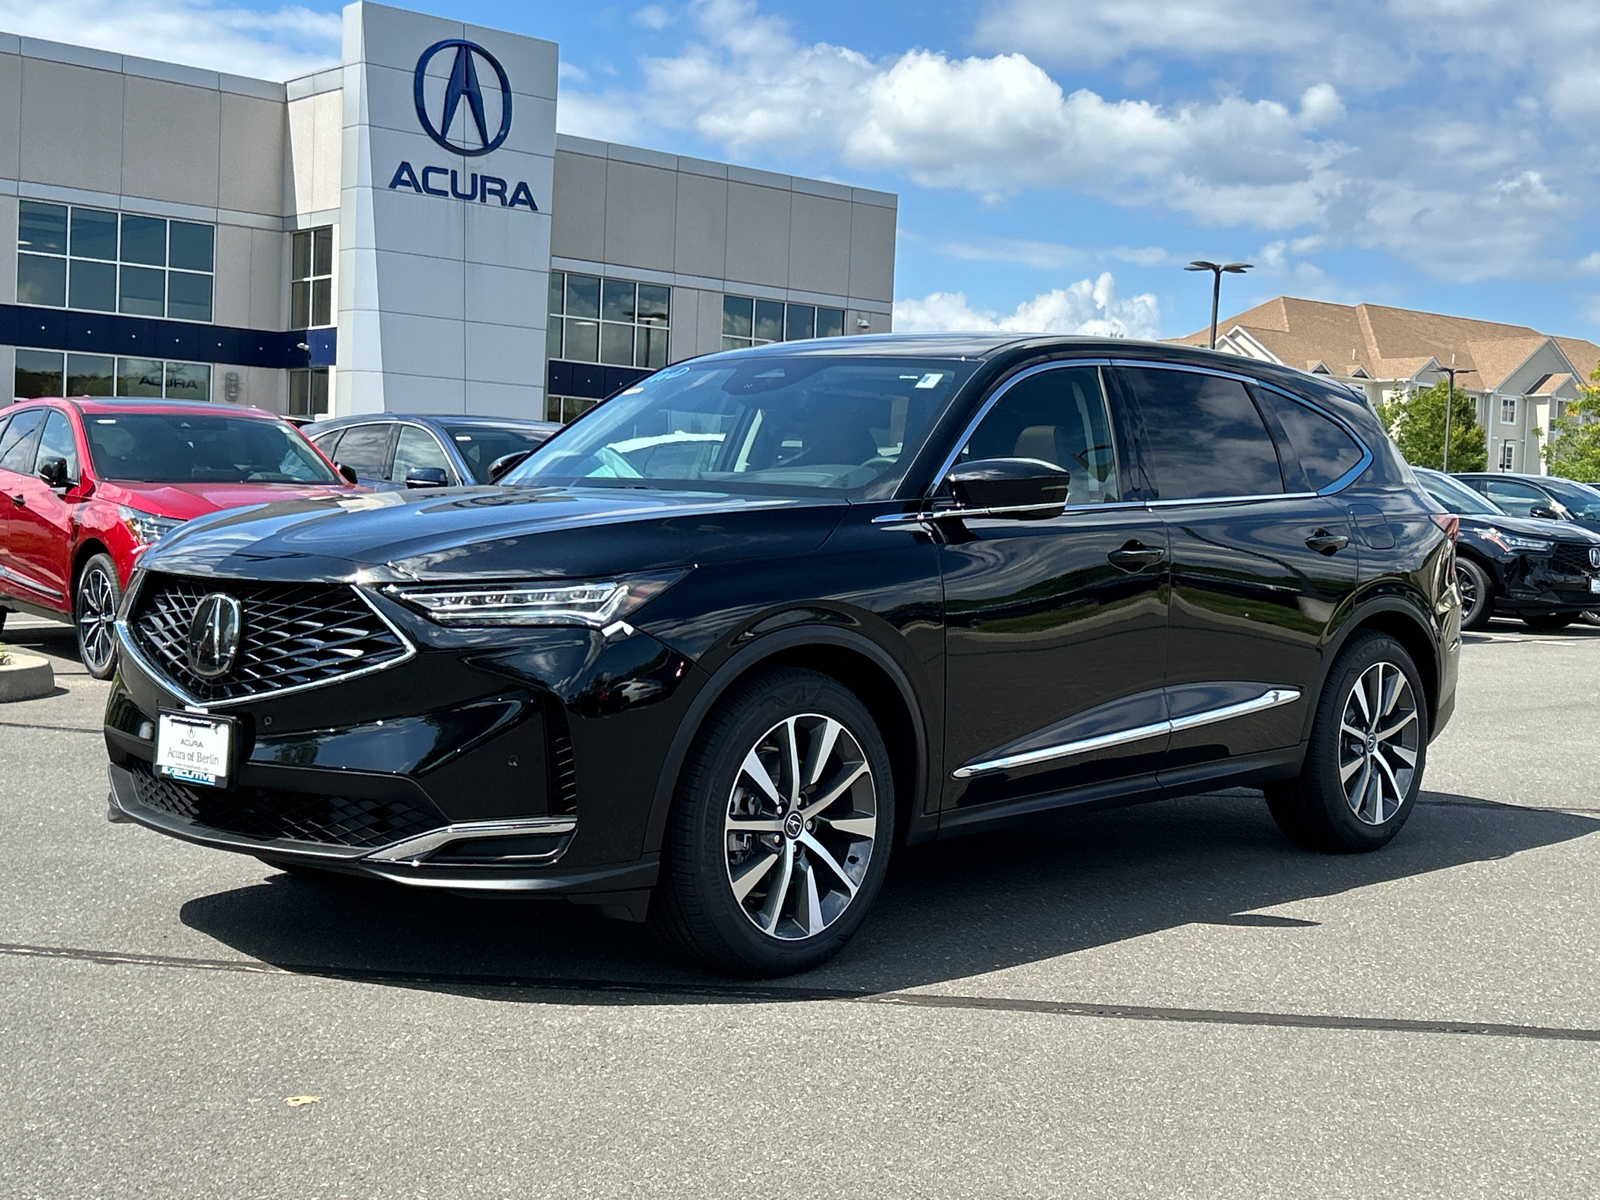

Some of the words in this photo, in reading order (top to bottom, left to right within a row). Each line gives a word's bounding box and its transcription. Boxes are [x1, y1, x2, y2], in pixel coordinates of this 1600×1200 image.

[388, 161, 538, 211] ACURA
[180, 738, 204, 748] ACURA
[167, 747, 186, 760] Acura
[187, 752, 195, 761] of
[196, 752, 219, 765] Berlin
